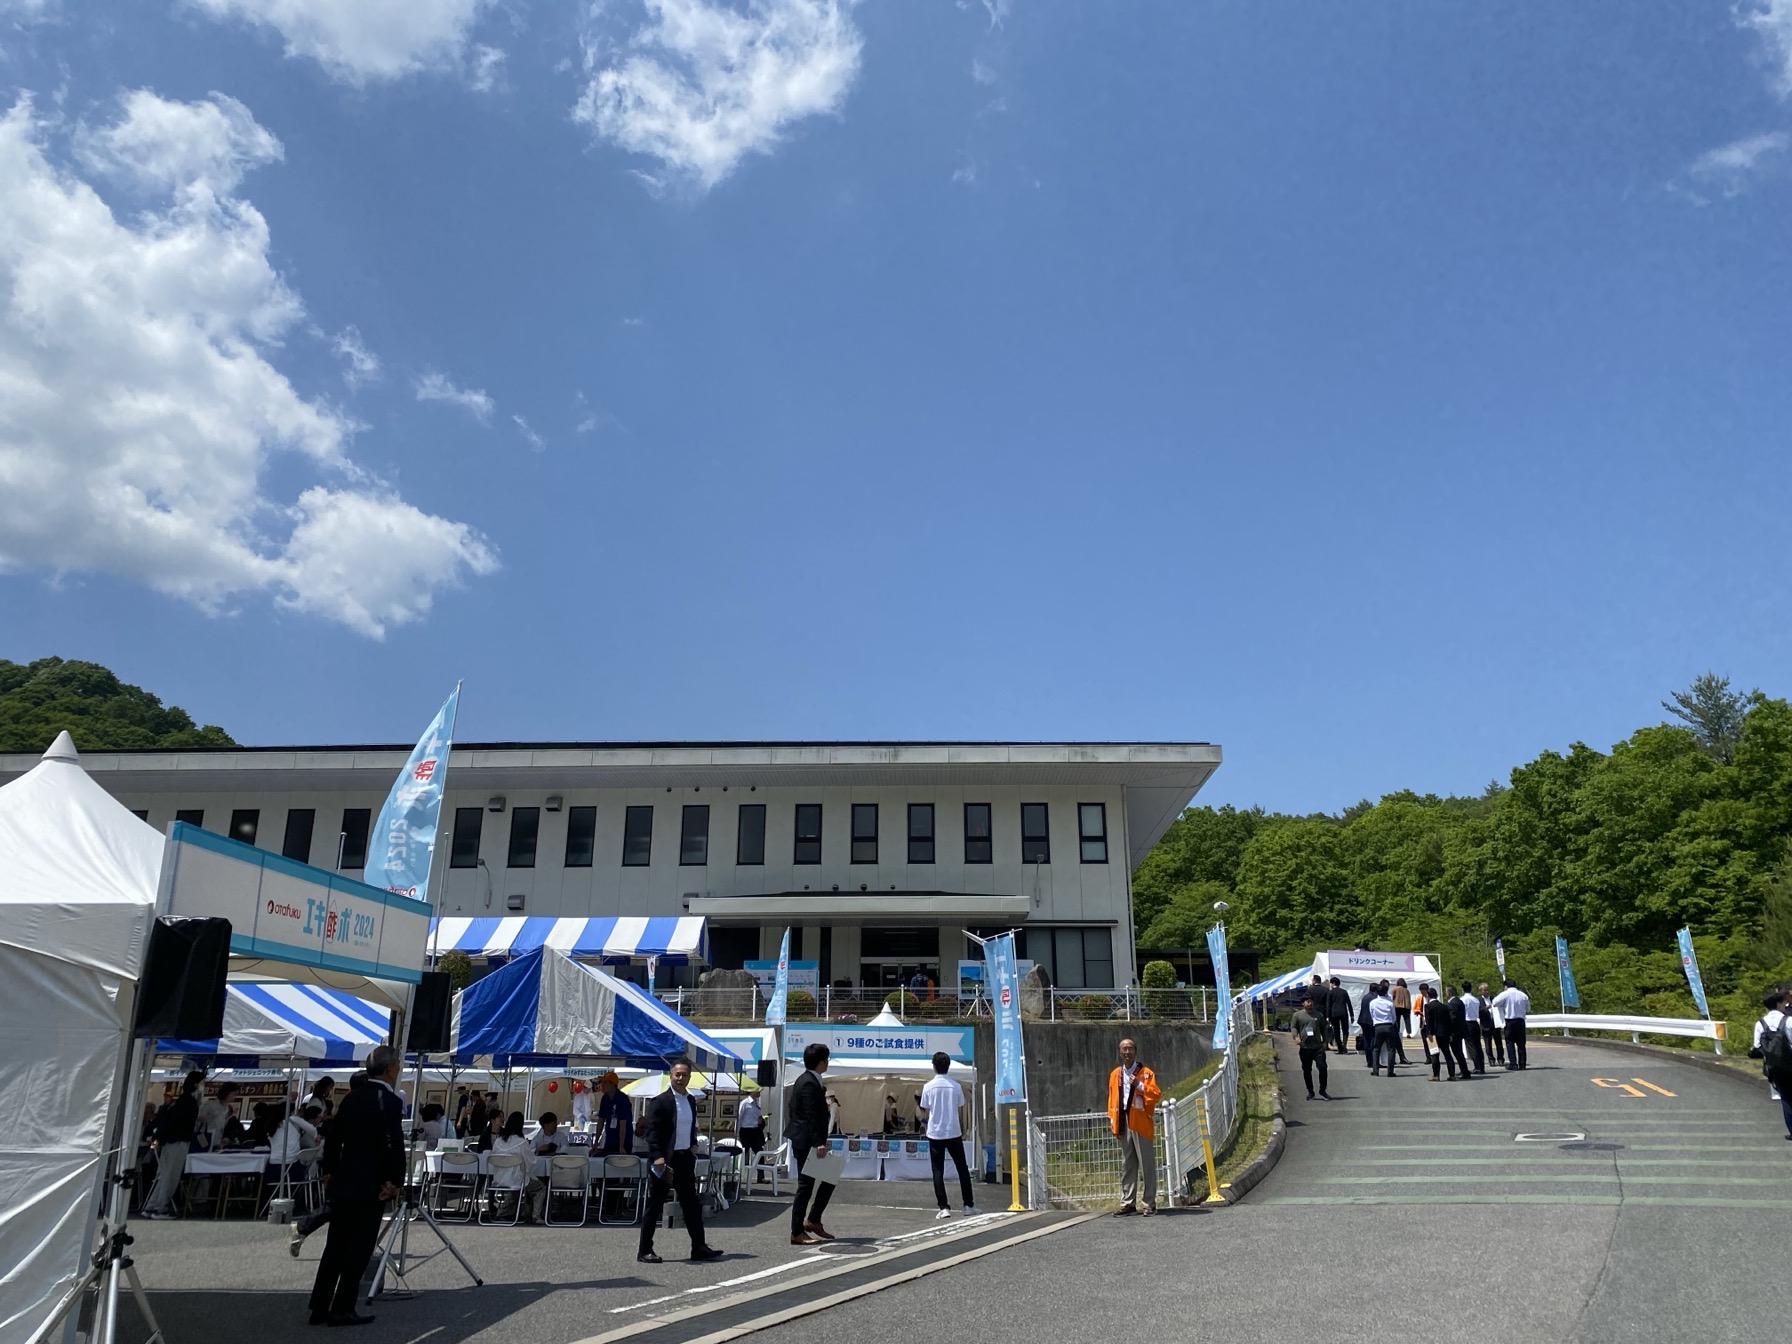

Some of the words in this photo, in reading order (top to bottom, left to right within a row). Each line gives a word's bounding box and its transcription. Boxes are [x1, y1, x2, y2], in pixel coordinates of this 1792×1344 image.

[353, 913, 375, 939] 2024
[1347, 956, 1395, 966] ドリンクコーナー
[847, 1037, 925, 1050] 9種のご試食提供
